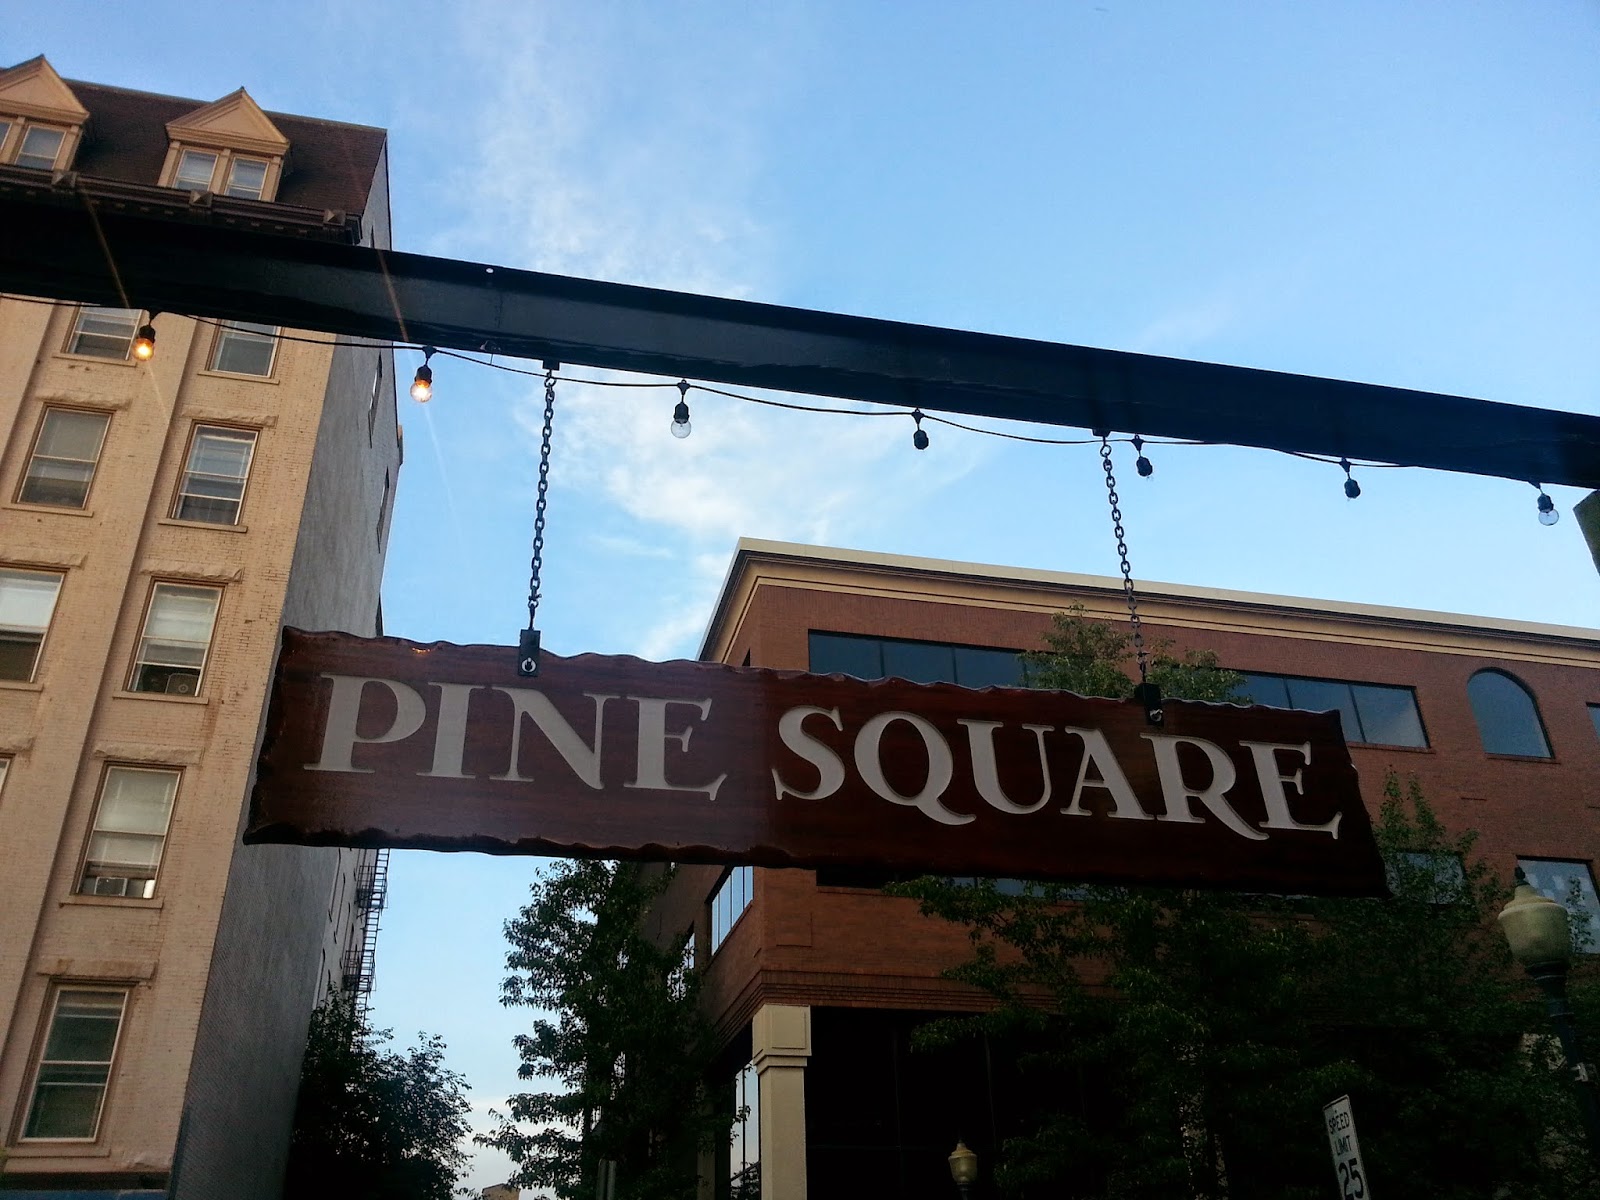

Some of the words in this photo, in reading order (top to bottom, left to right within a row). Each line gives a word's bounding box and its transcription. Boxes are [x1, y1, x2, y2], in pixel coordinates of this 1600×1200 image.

[303, 672, 728, 802] PINE
[772, 704, 1341, 841] SQUARE
[1328, 1111, 1350, 1135] SPEED
[1334, 1135, 1352, 1156] LIMIT
[1339, 1157, 1364, 1200] 25
